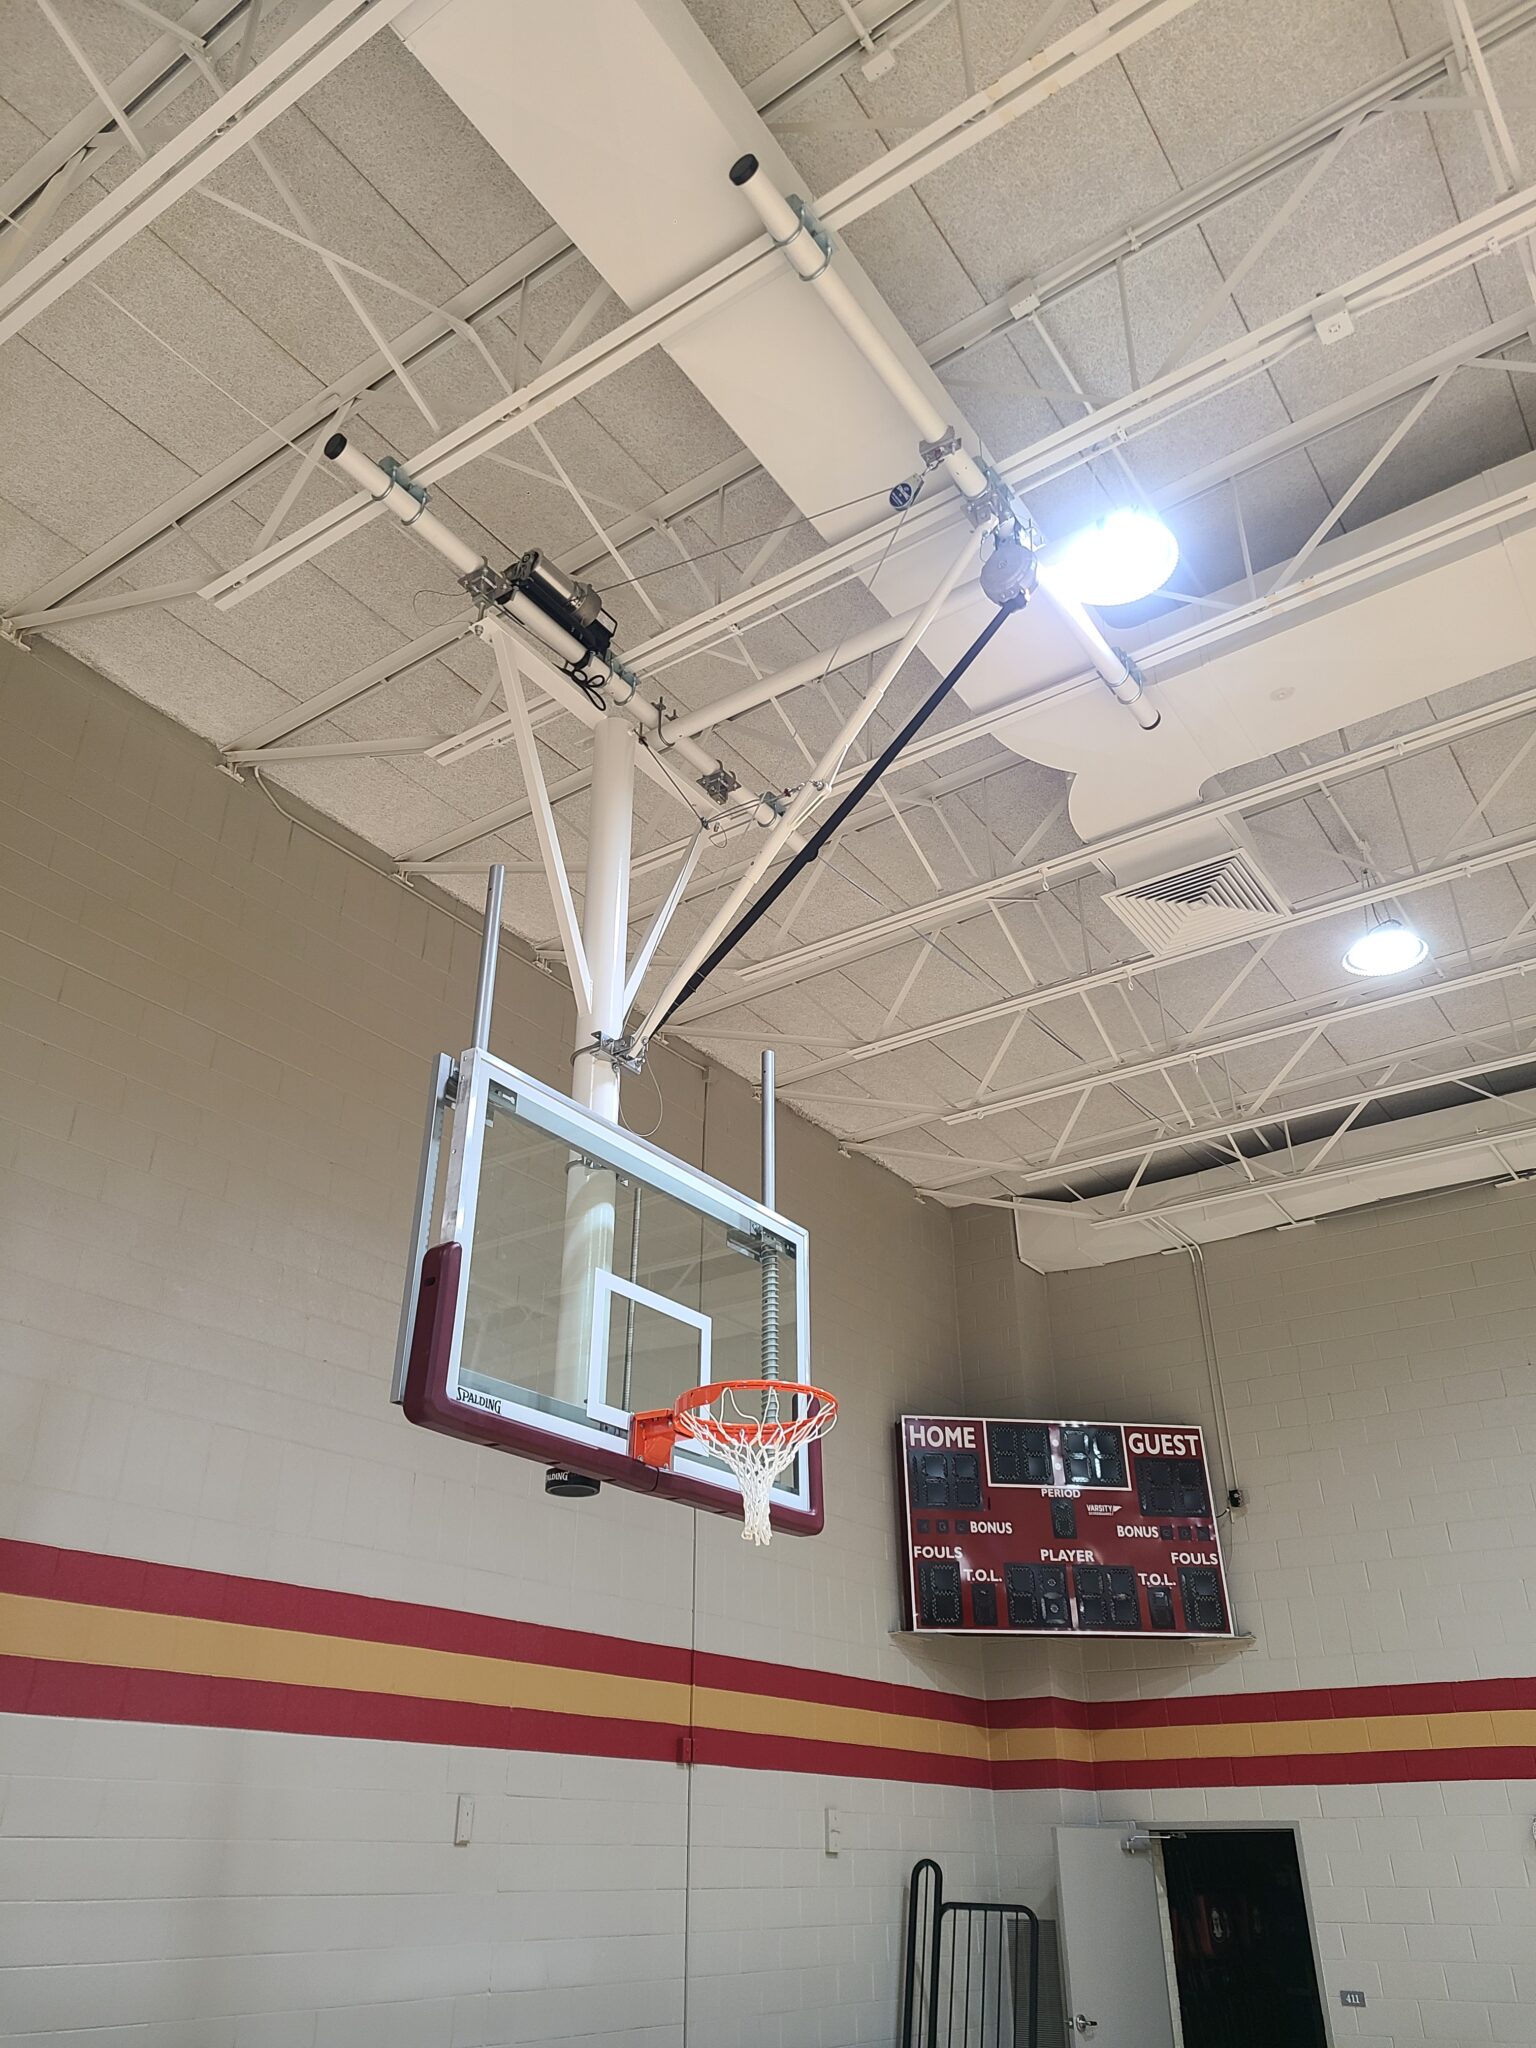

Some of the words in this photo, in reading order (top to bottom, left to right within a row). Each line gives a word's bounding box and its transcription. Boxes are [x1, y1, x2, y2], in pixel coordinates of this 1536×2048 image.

[456, 1387, 501, 1414] SPALDING
[909, 1425, 976, 1449] HOME
[1128, 1433, 1199, 1456] GUEST
[1041, 1488, 1081, 1499] PERIOD
[1086, 1504, 1113, 1512] VARSITY
[970, 1521, 1013, 1535] BONUS
[1117, 1526, 1159, 1539] BONUS
[914, 1546, 963, 1559] FOULS
[1040, 1549, 1094, 1563] PLAYER
[1171, 1553, 1218, 1566] FOULS
[963, 1569, 1002, 1582] T.O.L.
[1138, 1573, 1176, 1586] T.O.L.
[1345, 1994, 1360, 2004] 411
